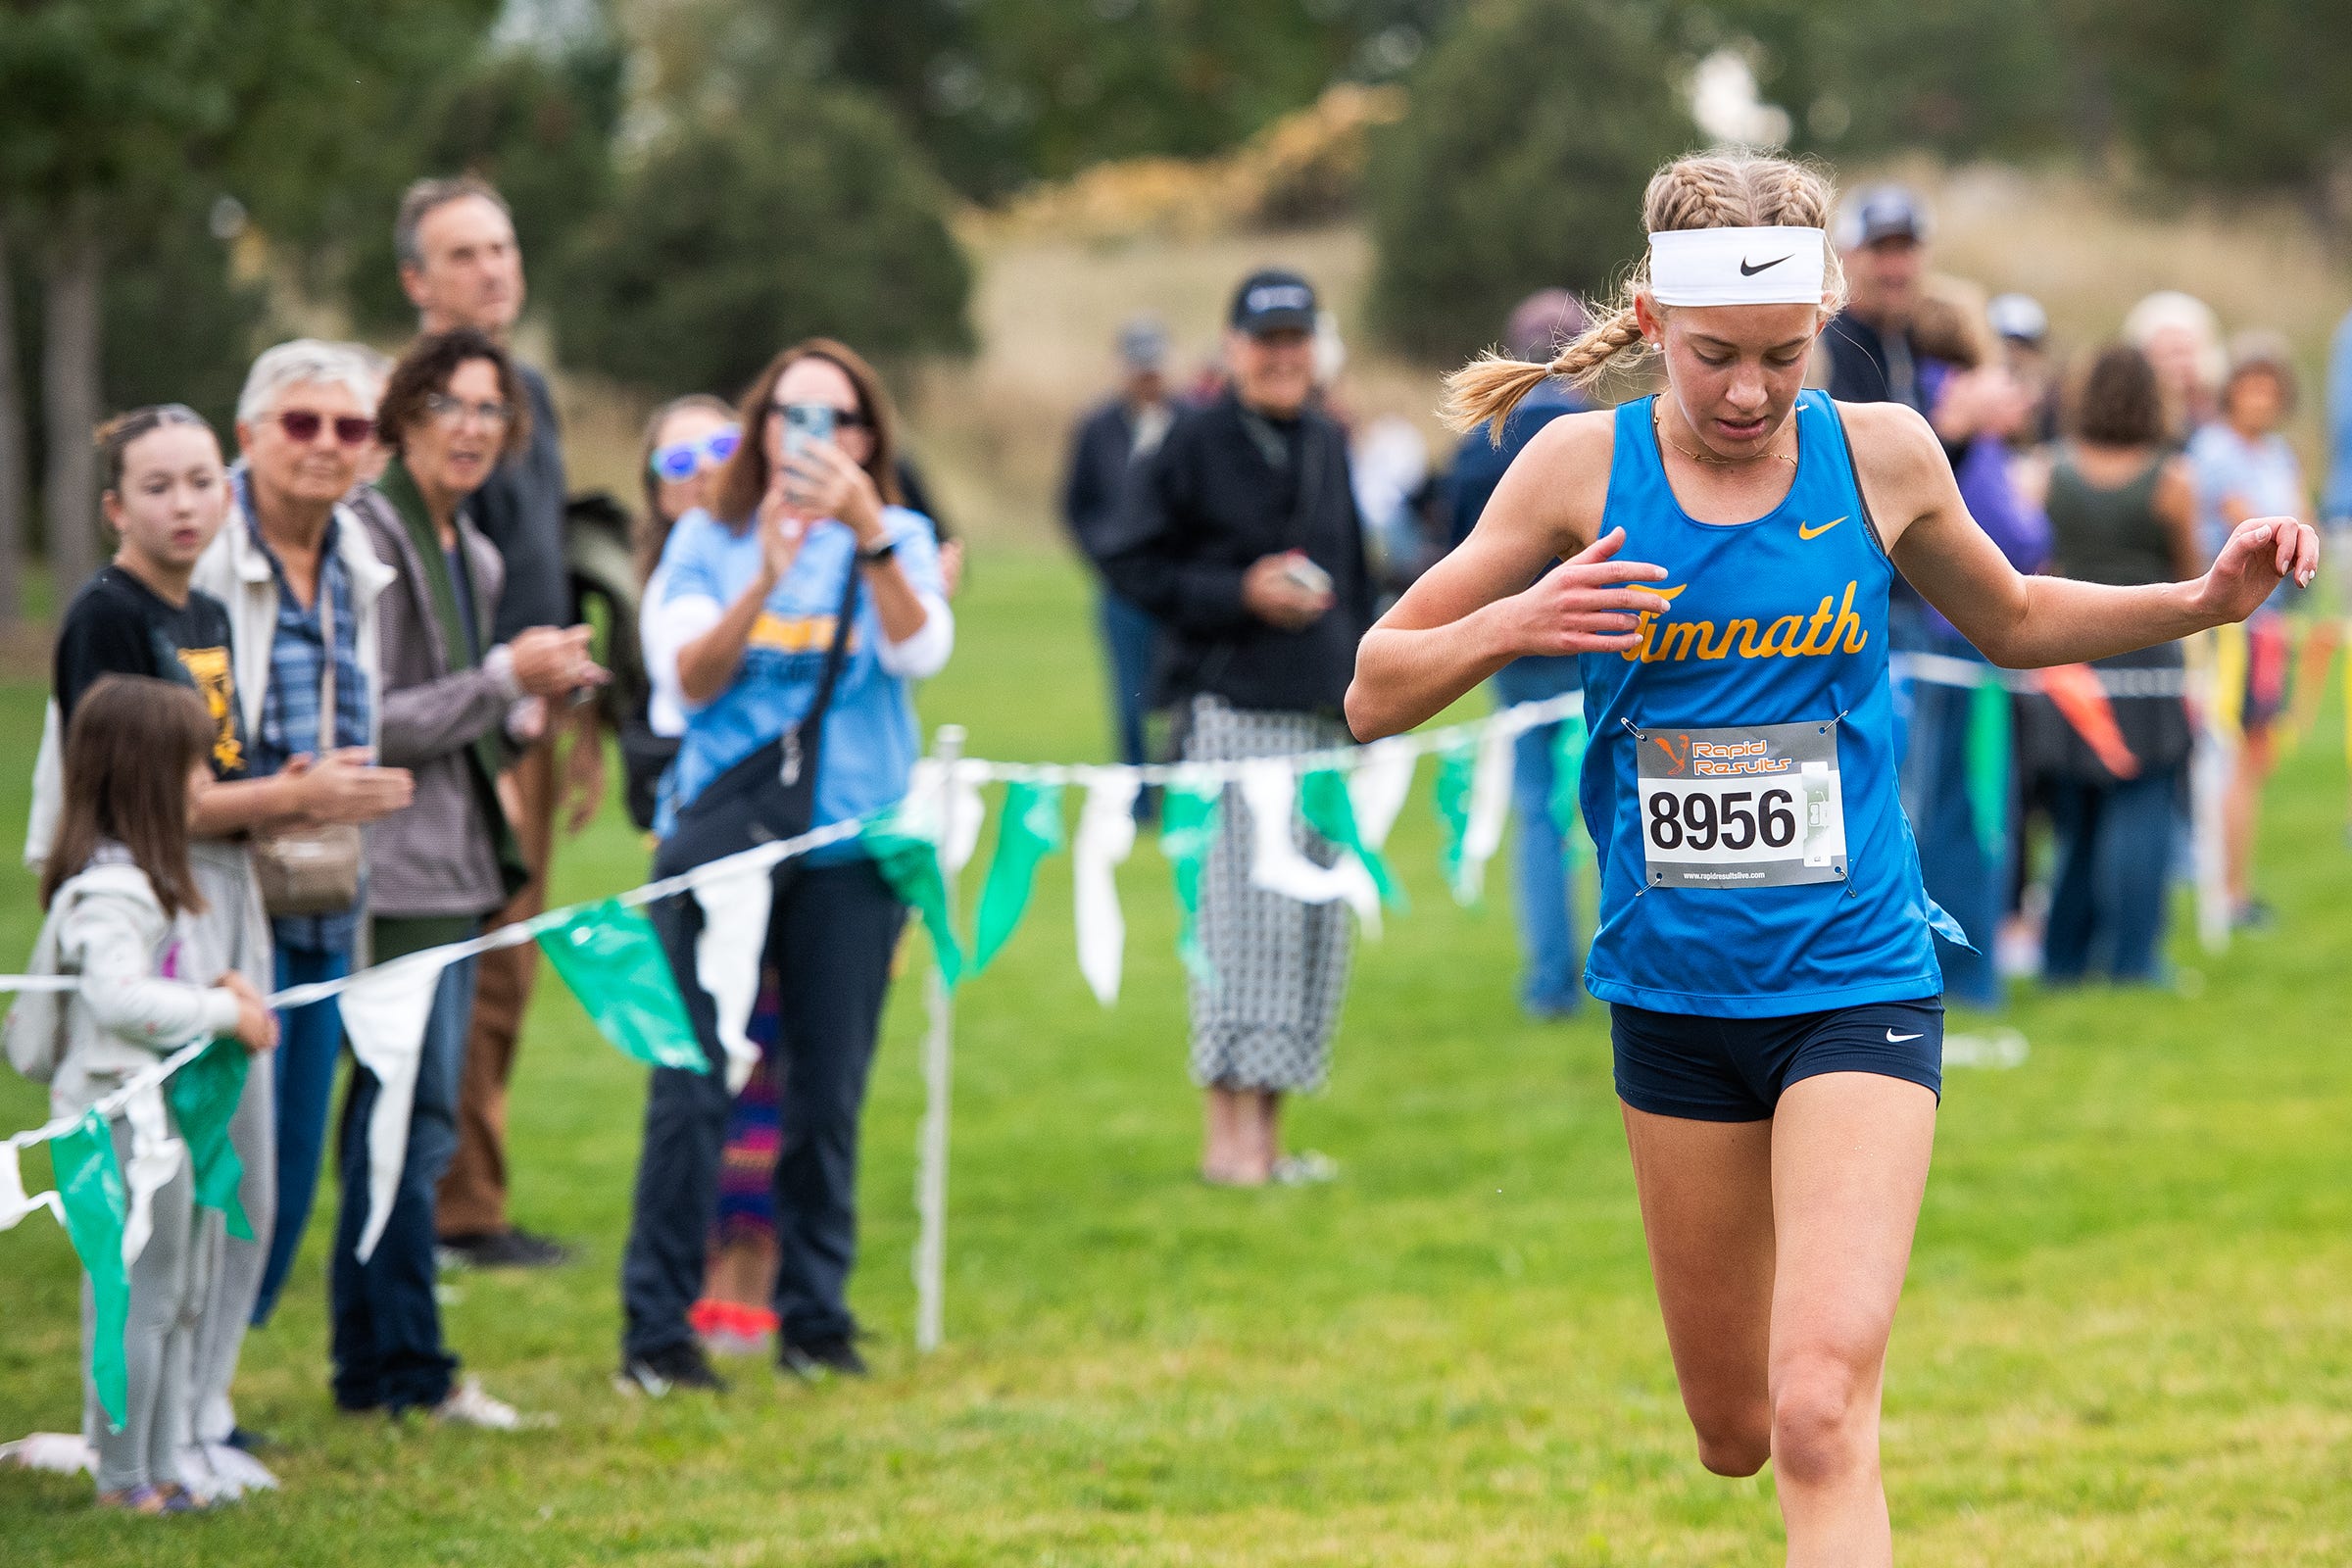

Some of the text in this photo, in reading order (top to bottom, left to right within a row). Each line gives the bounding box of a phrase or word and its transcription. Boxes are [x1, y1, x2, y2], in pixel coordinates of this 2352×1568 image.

[1692, 739, 1767, 760] Rapid
[1693, 758, 1792, 776] Results
[1648, 788, 1796, 851] 8956
[1683, 870, 1766, 881] www.rapidresultslive.com
